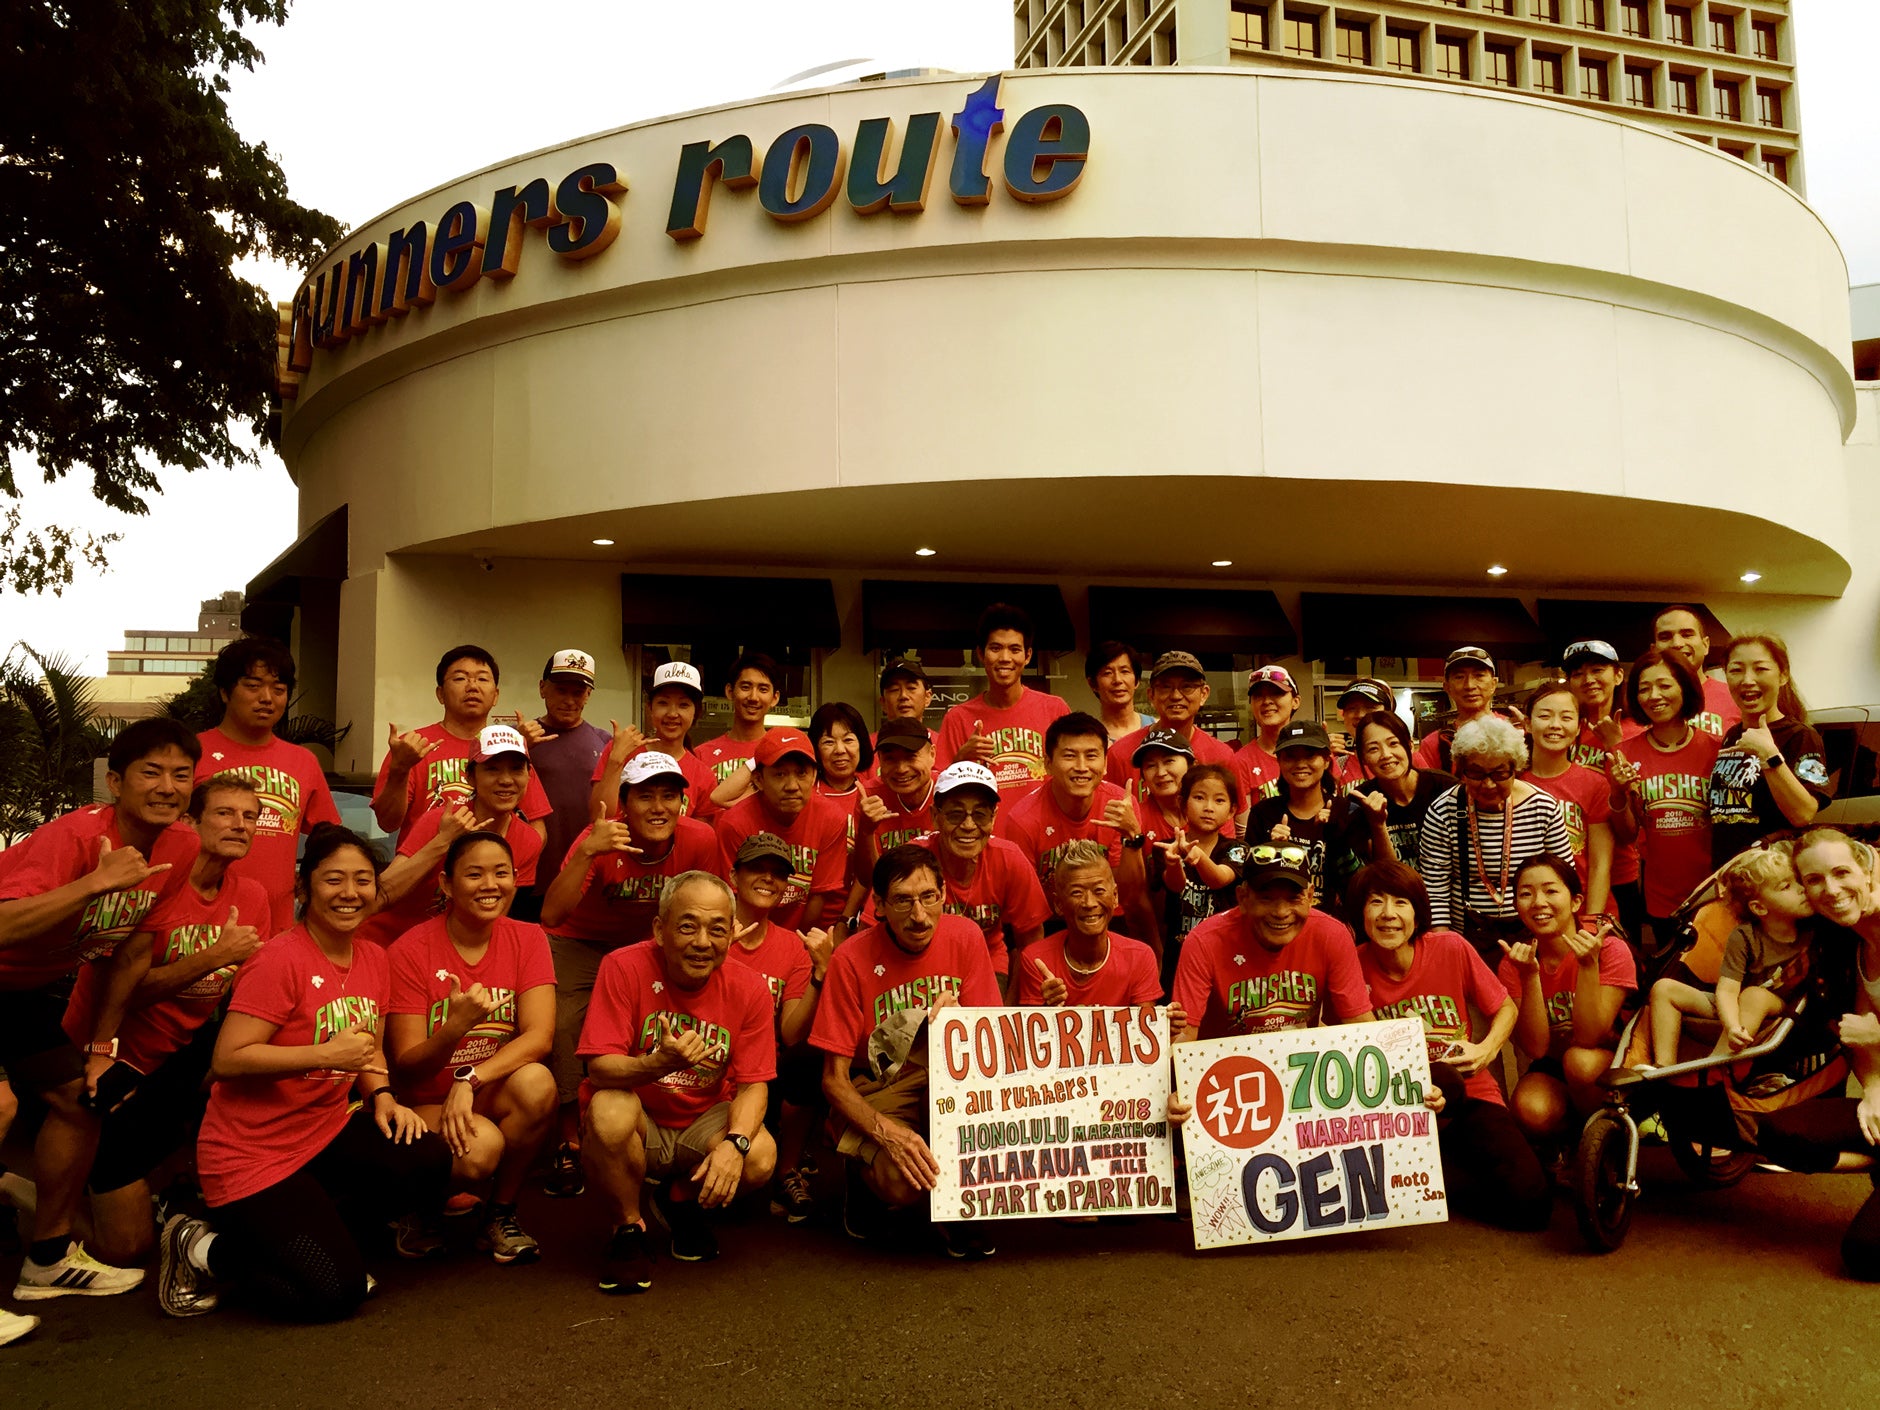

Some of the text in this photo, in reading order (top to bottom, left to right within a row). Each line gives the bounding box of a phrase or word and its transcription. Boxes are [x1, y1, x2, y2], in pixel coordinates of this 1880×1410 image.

[288, 72, 1090, 372] runners route
[486, 739, 520, 747] ALOHA
[986, 727, 1043, 758] NISHER
[1715, 759, 1742, 774] TART
[1227, 969, 1317, 1015] FINISHER
[314, 996, 379, 1045] FINISHE
[1264, 1015, 1285, 1026] 2018
[452, 1042, 499, 1057] HONOLULU
[466, 1038, 488, 1049] 2018
[943, 1006, 1160, 1081] CONGRATS
[1287, 1045, 1424, 1113] 700th
[965, 1090, 993, 1115] all
[1100, 1098, 1152, 1122] 2018
[1206, 1071, 1271, 1137] 祝
[957, 1116, 1168, 1155] HONOLULU MARATHON
[1295, 1111, 1430, 1150] MARATHON
[959, 1142, 1147, 1188] KALAKAUA MERRIE
[1109, 1158, 1148, 1176] MILE
[1390, 1171, 1430, 1189] Moto
[960, 1182, 1041, 1219] START
[1044, 1189, 1067, 1212] to
[1068, 1176, 1133, 1211] PARK
[1242, 1143, 1389, 1234] GEN
[1208, 1196, 1233, 1228] WOW!!
